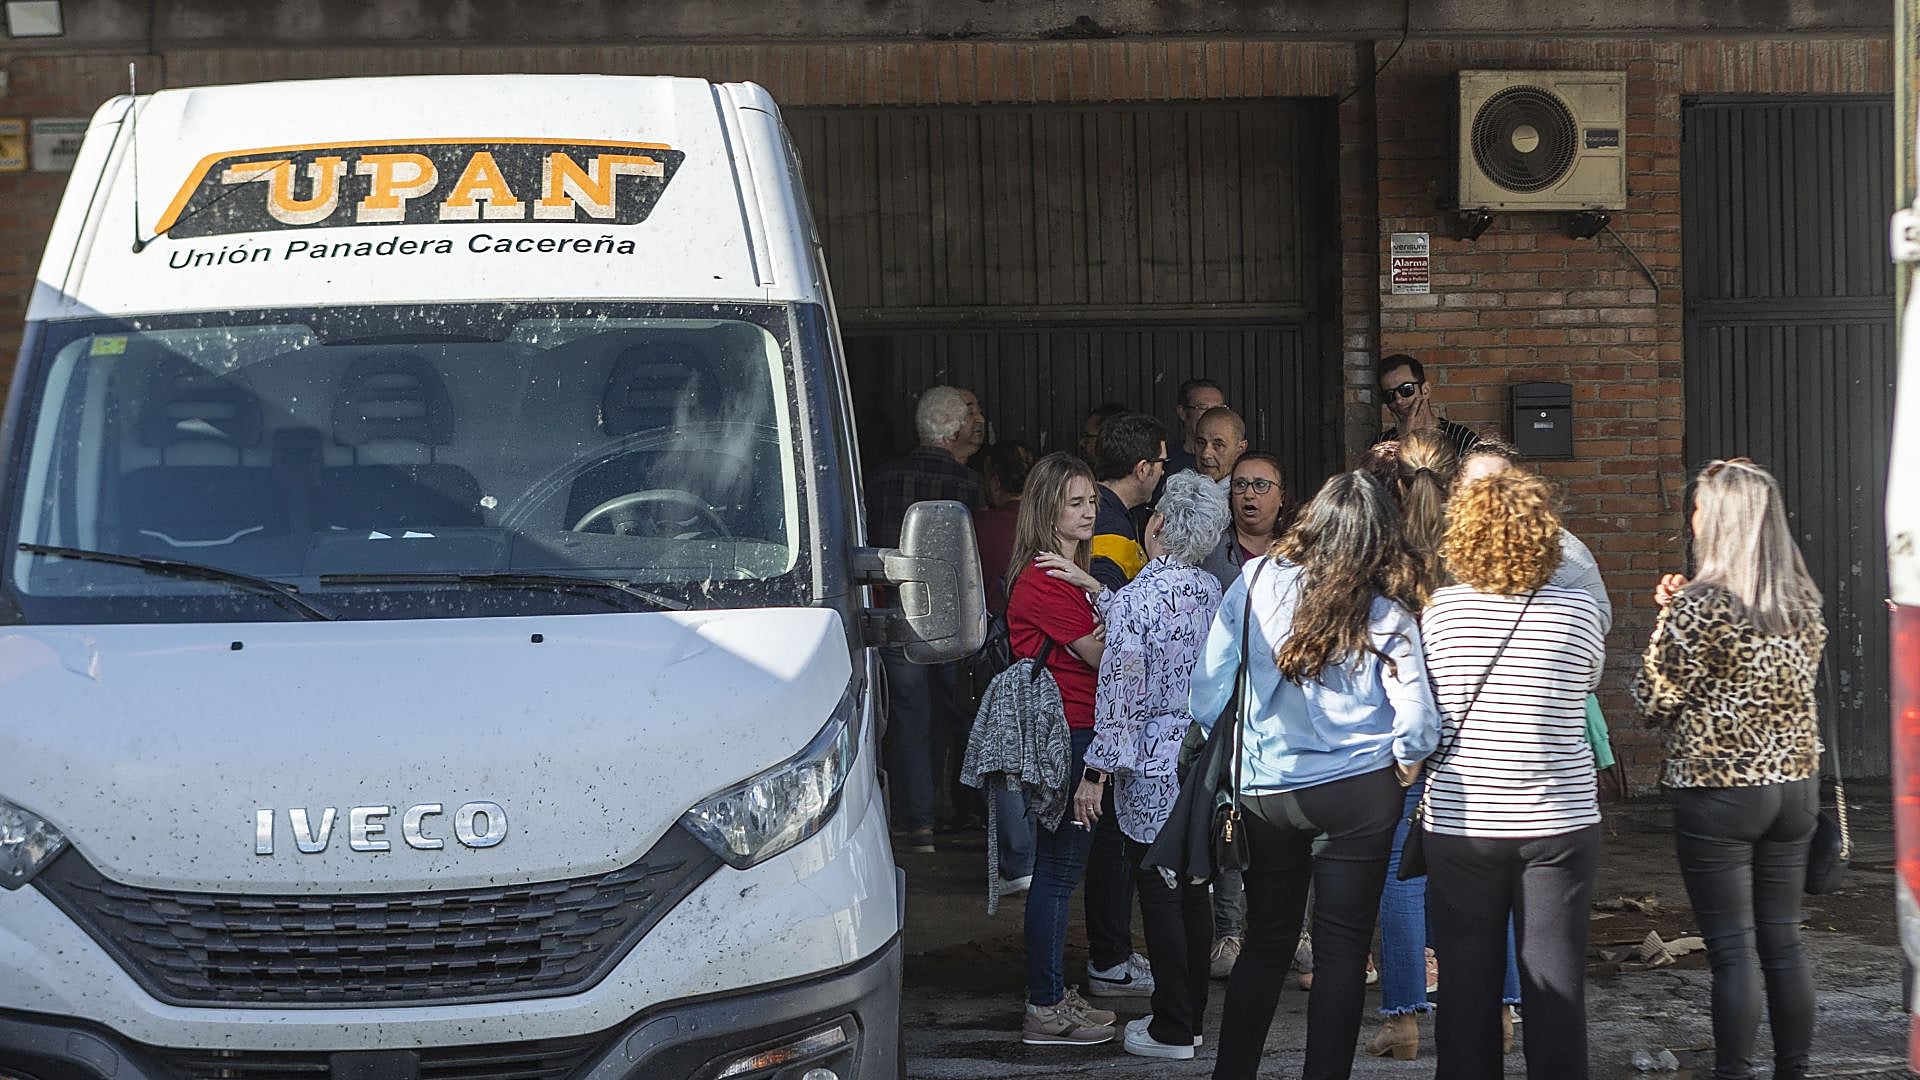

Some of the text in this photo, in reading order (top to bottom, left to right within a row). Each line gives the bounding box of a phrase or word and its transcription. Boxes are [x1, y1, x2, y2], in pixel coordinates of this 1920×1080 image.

[222, 152, 664, 225] UPAN
[169, 233, 636, 270] Unión Panadera Cacereña
[1394, 259, 1427, 267] Alarma
[255, 800, 508, 855] IVECO
